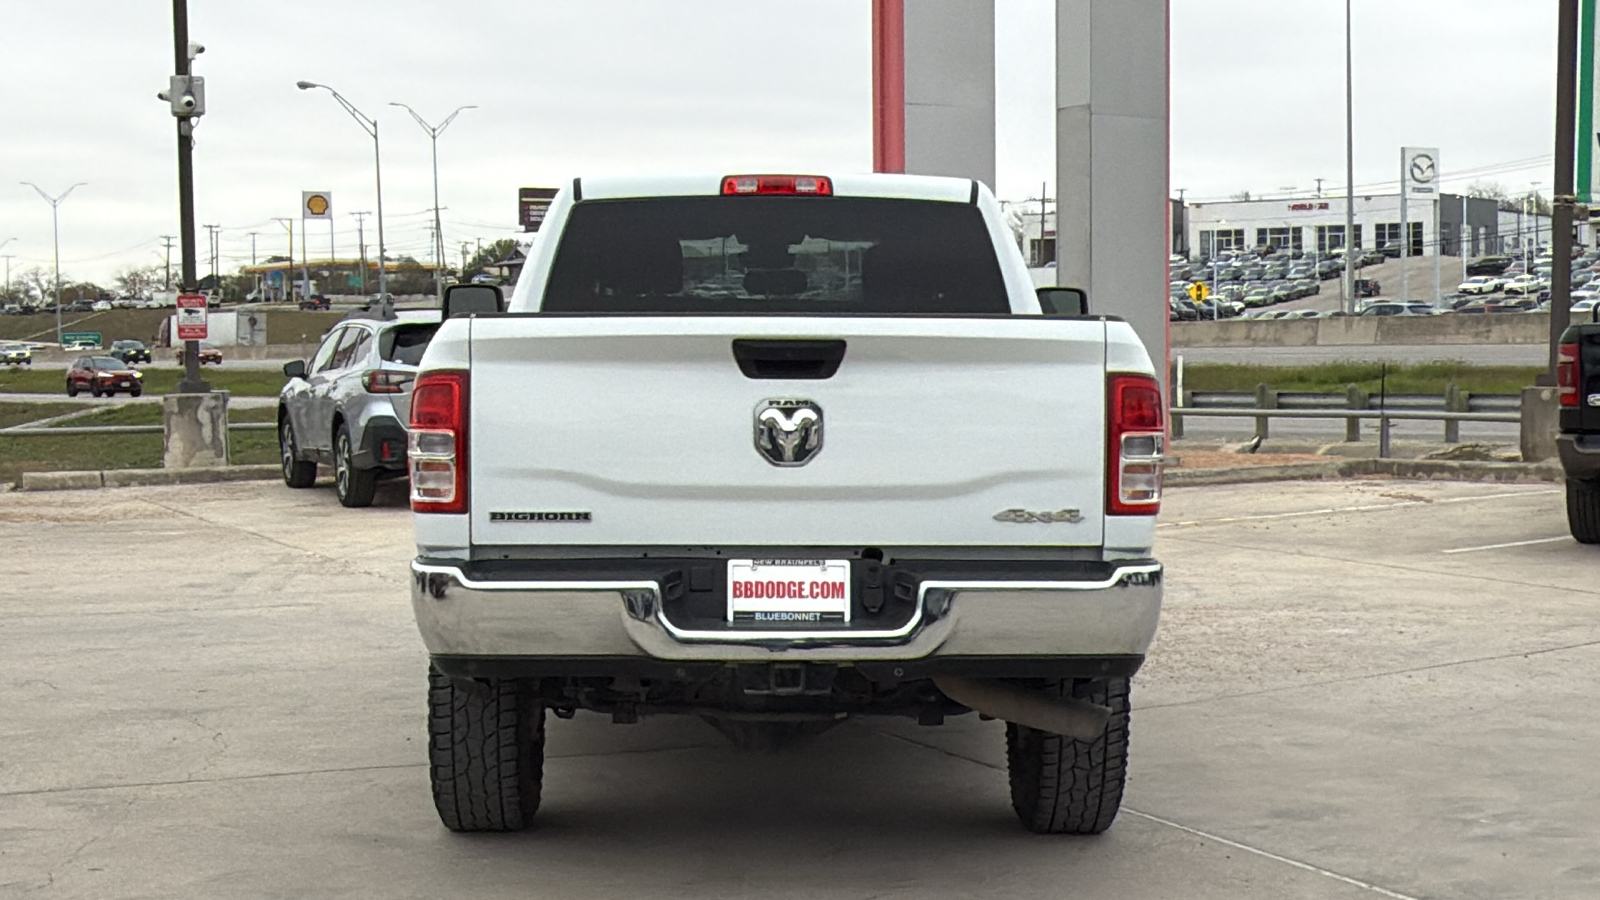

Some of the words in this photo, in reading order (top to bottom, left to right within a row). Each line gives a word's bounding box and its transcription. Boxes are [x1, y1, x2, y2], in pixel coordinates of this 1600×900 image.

[490, 511, 592, 522] BIGHORN
[732, 580, 845, 599] BBDODGE.COM
[754, 612, 821, 621] BLUEBONNET
